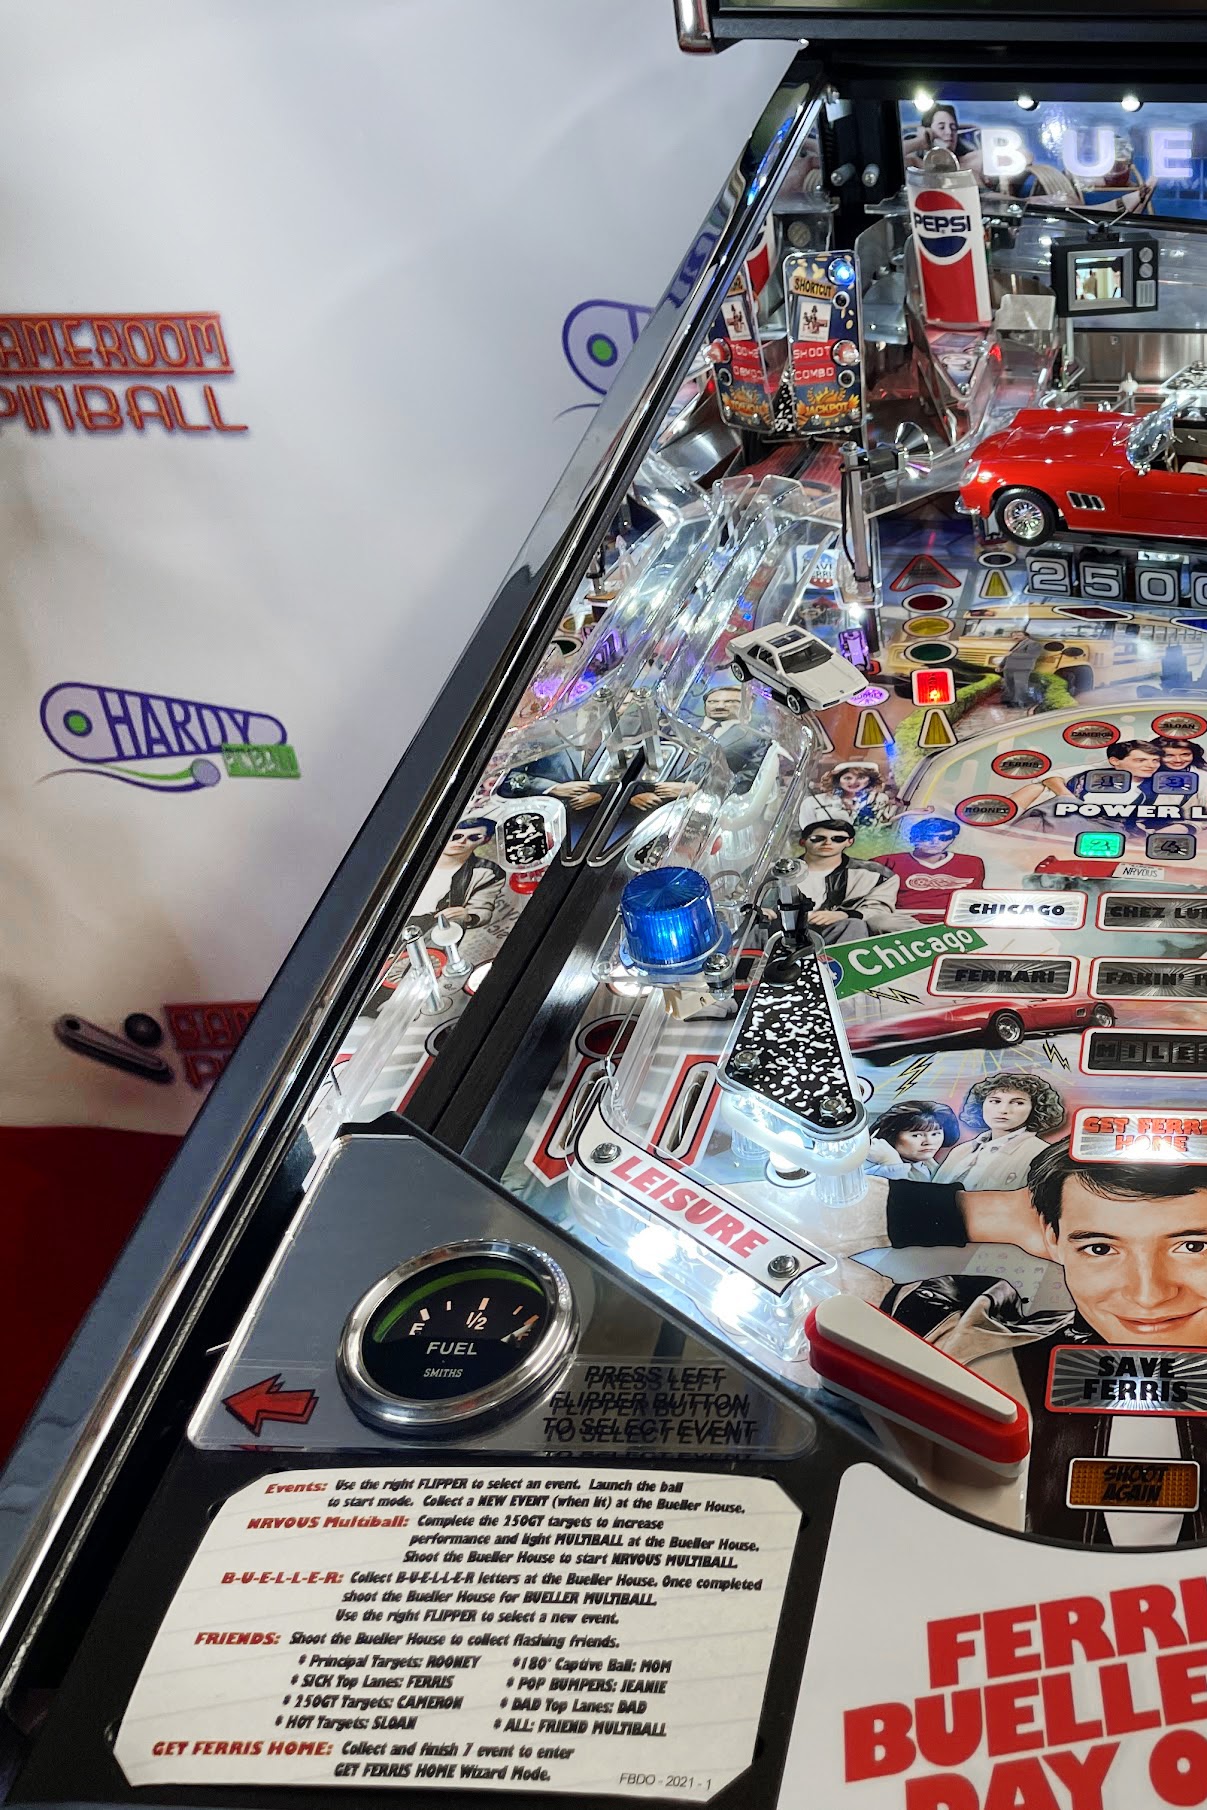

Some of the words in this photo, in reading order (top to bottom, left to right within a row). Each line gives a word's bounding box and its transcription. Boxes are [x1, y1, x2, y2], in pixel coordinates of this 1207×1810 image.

[913, 212, 971, 232] PEPSI
[794, 277, 835, 298] SHORTCUT
[793, 345, 831, 359] SHOOT
[794, 368, 834, 380] COMBO
[805, 401, 849, 416] JACKPOT
[98, 687, 250, 757] HARDY
[1162, 722, 1195, 730] SLOAN
[1000, 760, 1040, 769] FERRIS
[1168, 775, 1184, 788] 3
[965, 806, 1008, 815] ROONEY
[1055, 803, 1181, 818] POWER
[1090, 839, 1109, 853] 2
[1161, 840, 1180, 854] 4
[969, 903, 1065, 916] CHICAGO
[1109, 906, 1165, 919] CHEZ
[847, 927, 974, 976] Chicago
[954, 969, 1055, 984] FERRARI
[1105, 971, 1184, 987] FAKIN'
[1083, 1117, 1129, 1134] GET
[1115, 1135, 1189, 1152] HOME
[611, 1156, 770, 1260] LEISURE
[466, 1311, 488, 1330] 1/2
[426, 1341, 477, 1355] FUEL
[423, 1368, 463, 1378] SMITHS
[1097, 1355, 1174, 1378] SAVE
[584, 1366, 664, 1386] PRESS
[667, 1368, 725, 1387] LEFT
[1083, 1379, 1190, 1402] FERRIS
[549, 1391, 648, 1411] FLIPPER
[653, 1393, 750, 1413] BUTTON
[543, 1418, 573, 1438] TO
[578, 1418, 673, 1439] SELECT
[677, 1420, 758, 1441] EVENT
[1103, 1465, 1170, 1483] SHOOT
[265, 1482, 328, 1494] Events:
[336, 1480, 356, 1490] Use
[360, 1479, 379, 1490] the
[382, 1479, 415, 1491] right
[417, 1478, 468, 1489] FLIPPER
[472, 1479, 484, 1489] to
[487, 1478, 523, 1489] select
[526, 1480, 541, 1489] an
[545, 1479, 580, 1489] event.
[589, 1479, 632, 1491] Launch
[637, 1481, 656, 1492] the
[660, 1481, 683, 1493] ball
[1101, 1483, 1164, 1503] AGAIN
[247, 1517, 320, 1529] NRVOUS
[323, 1516, 409, 1527] Multiball:
[418, 1515, 474, 1528] Complete
[479, 1515, 499, 1526] the
[503, 1515, 545, 1526] 250GT
[548, 1516, 592, 1529] targets
[597, 1517, 608, 1528] to
[612, 1517, 664, 1529] increase
[221, 1572, 344, 1584] B-U-E-L-L-E-R:
[351, 1571, 393, 1583] Collect
[395, 1572, 475, 1583] B-U-E-L-L-E-R
[478, 1572, 521, 1584] letters
[524, 1573, 538, 1584] at
[542, 1573, 562, 1585] the
[566, 1573, 613, 1585] Bueller
[616, 1574, 658, 1587] House.
[662, 1575, 692, 1588] Once
[697, 1578, 763, 1591] completed
[195, 1632, 281, 1645] FRIENDS:
[289, 1632, 327, 1644] Shoot
[331, 1632, 351, 1645] the
[355, 1632, 403, 1645] Bueller
[406, 1633, 445, 1645] House
[450, 1634, 463, 1646] to
[468, 1633, 510, 1646] collect
[513, 1633, 566, 1649] flashing
[569, 1635, 619, 1648] friends.
[309, 1655, 368, 1670] Principal
[371, 1655, 423, 1670] Targets:
[426, 1655, 481, 1668] ROONEY
[555, 1657, 603, 1673] Captive
[607, 1659, 636, 1672] Ball:
[640, 1660, 672, 1673] MOM
[153, 1741, 188, 1756] GET
[192, 1741, 264, 1755] FERRIS
[267, 1741, 333, 1755] HOME:
[342, 1742, 387, 1755] Collect
[390, 1742, 417, 1755] and
[420, 1743, 458, 1756] finish
[463, 1743, 473, 1756] 7
[477, 1745, 514, 1757] event
[519, 1745, 532, 1758] to
[537, 1746, 575, 1759] enter
[619, 1772, 656, 1785] FBDO
[665, 1775, 695, 1788] 2021
[706, 1779, 712, 1790] 1
